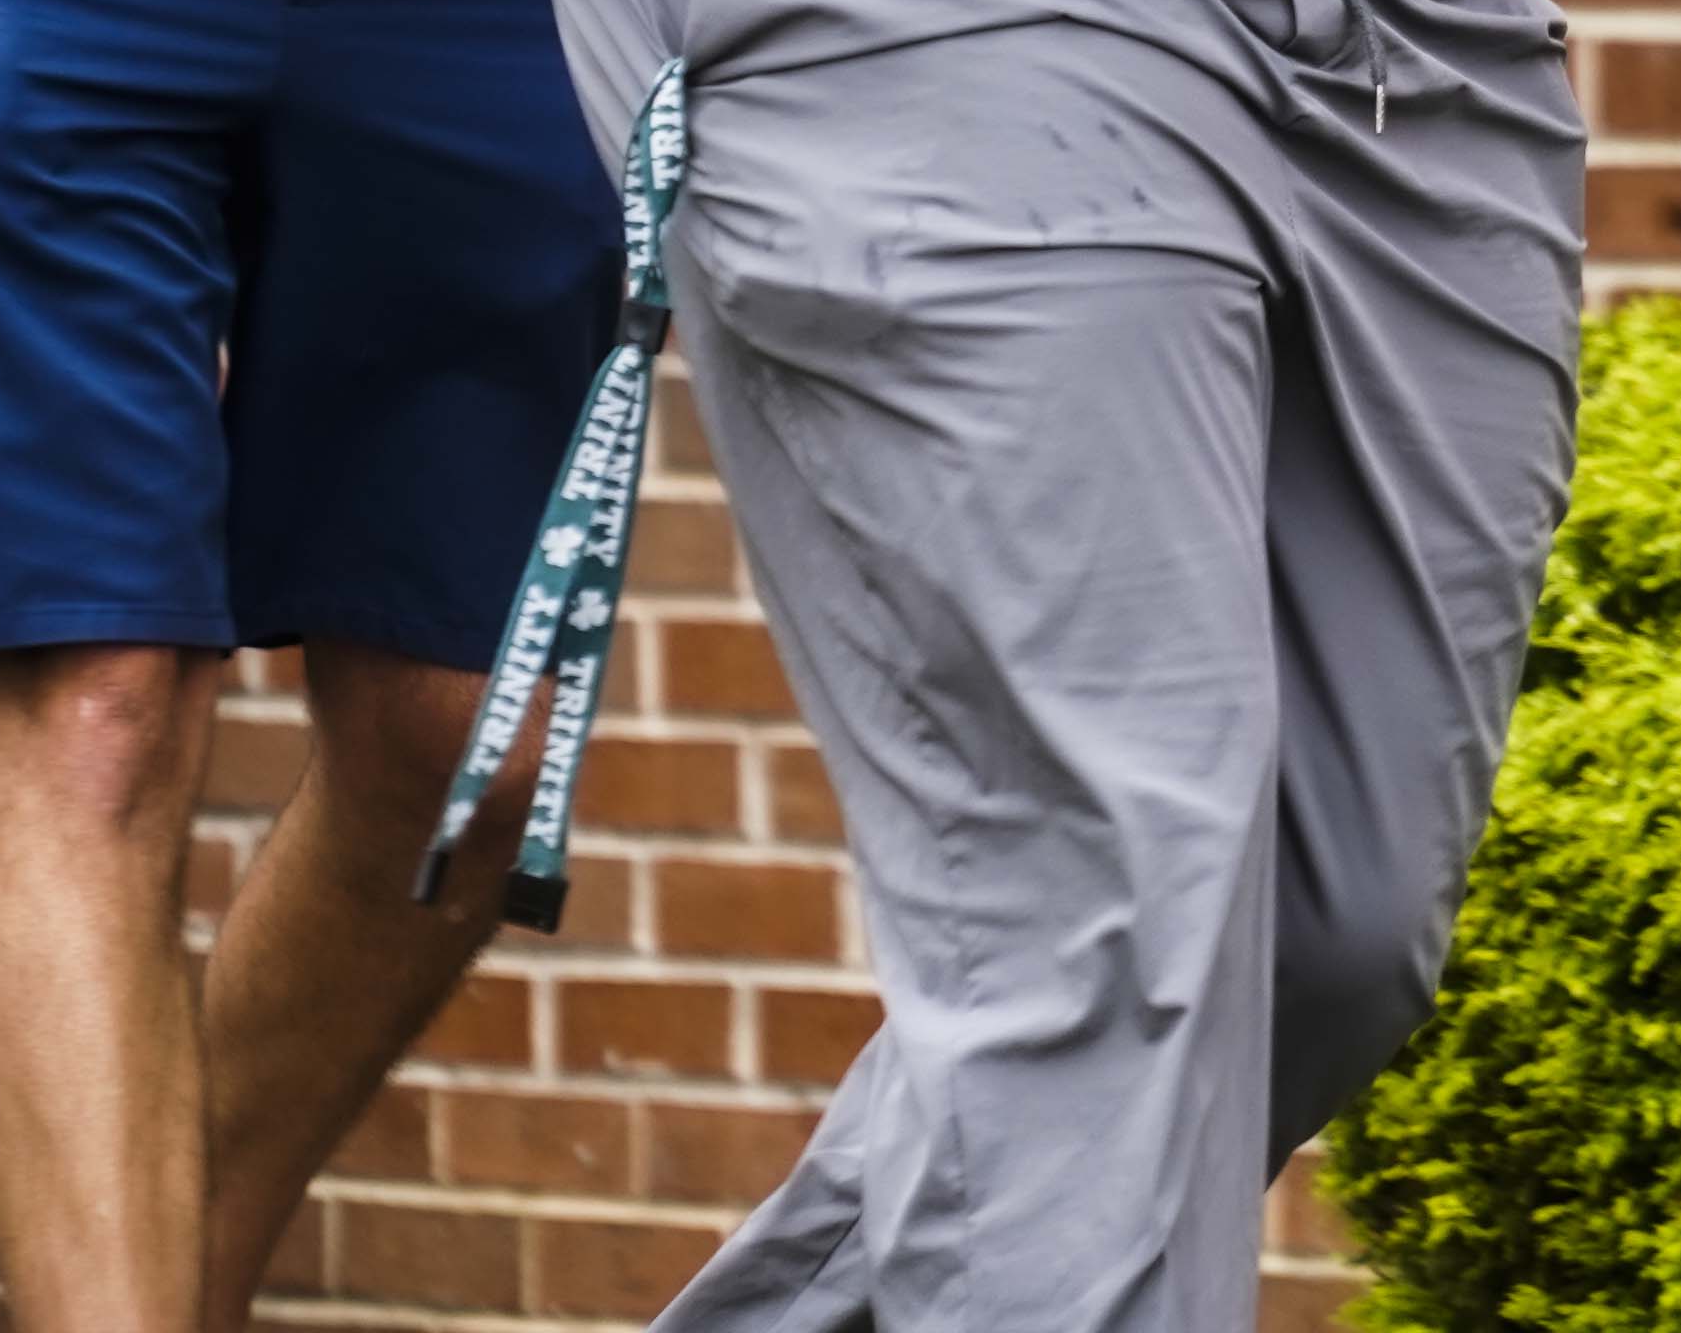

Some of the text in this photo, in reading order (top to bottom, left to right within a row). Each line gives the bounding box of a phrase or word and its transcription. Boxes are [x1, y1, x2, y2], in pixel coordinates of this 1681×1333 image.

[649, 61, 686, 190] TRIN
[465, 584, 563, 775] TRINITY
[524, 654, 599, 849] TRINITY
